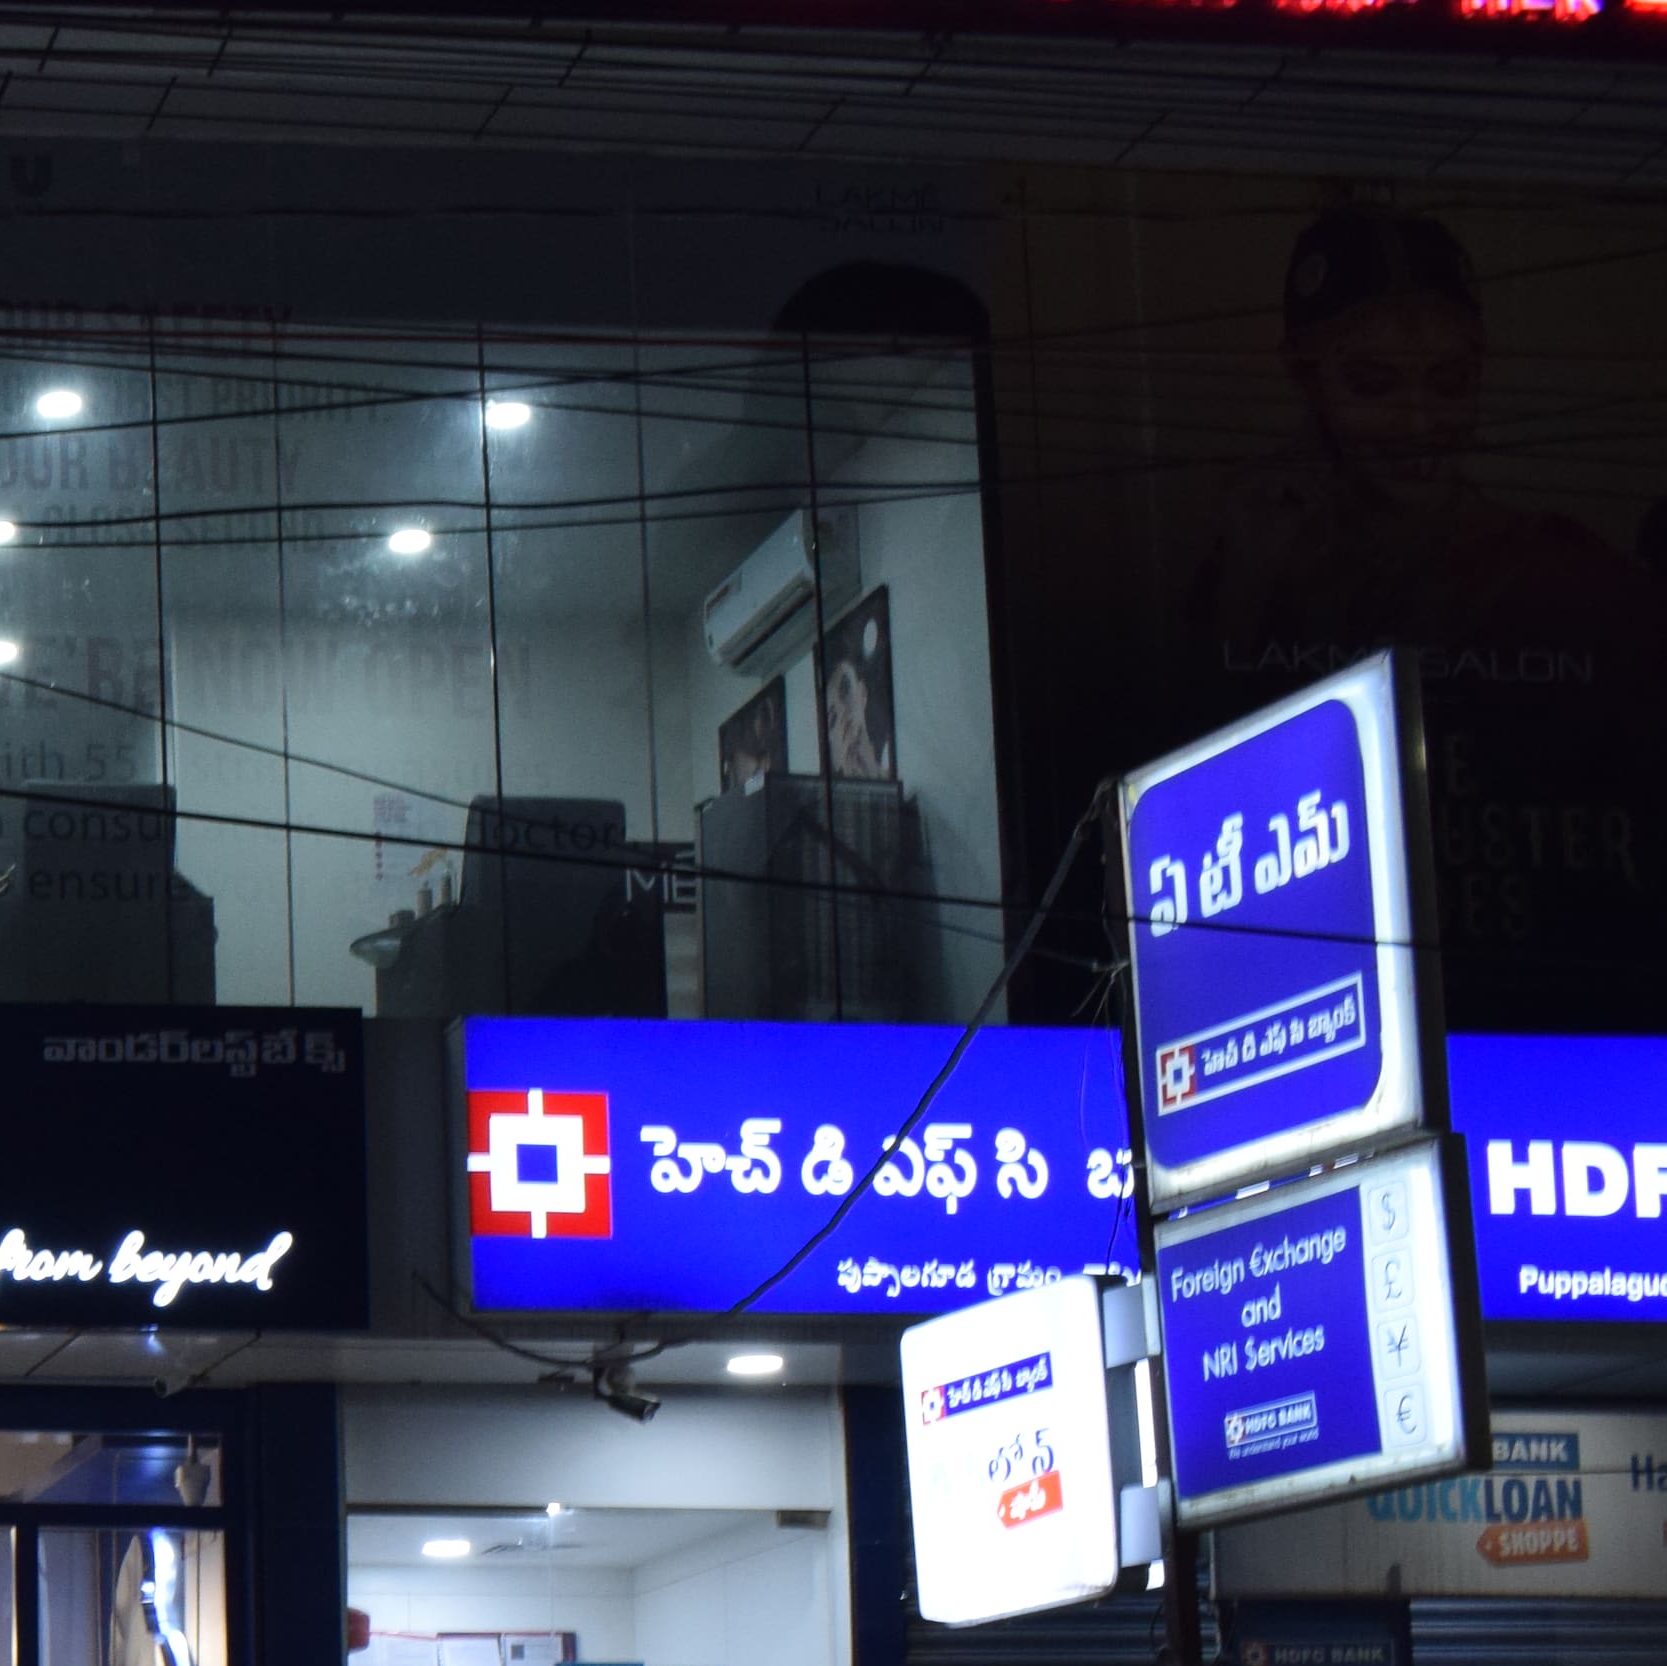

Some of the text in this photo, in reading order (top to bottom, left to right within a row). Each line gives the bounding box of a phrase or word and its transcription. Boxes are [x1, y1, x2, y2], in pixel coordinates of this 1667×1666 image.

[109, 1230, 294, 1308] beyond
[1171, 1257, 1245, 1303] Foreign
[1241, 1283, 1281, 1328] and
[1203, 1341, 1238, 1382] NRI
[1493, 1438, 1568, 1462] BANK
[1498, 1526, 1578, 1557] SHOPPE
[1274, 1646, 1385, 1666] HDFC BANK
